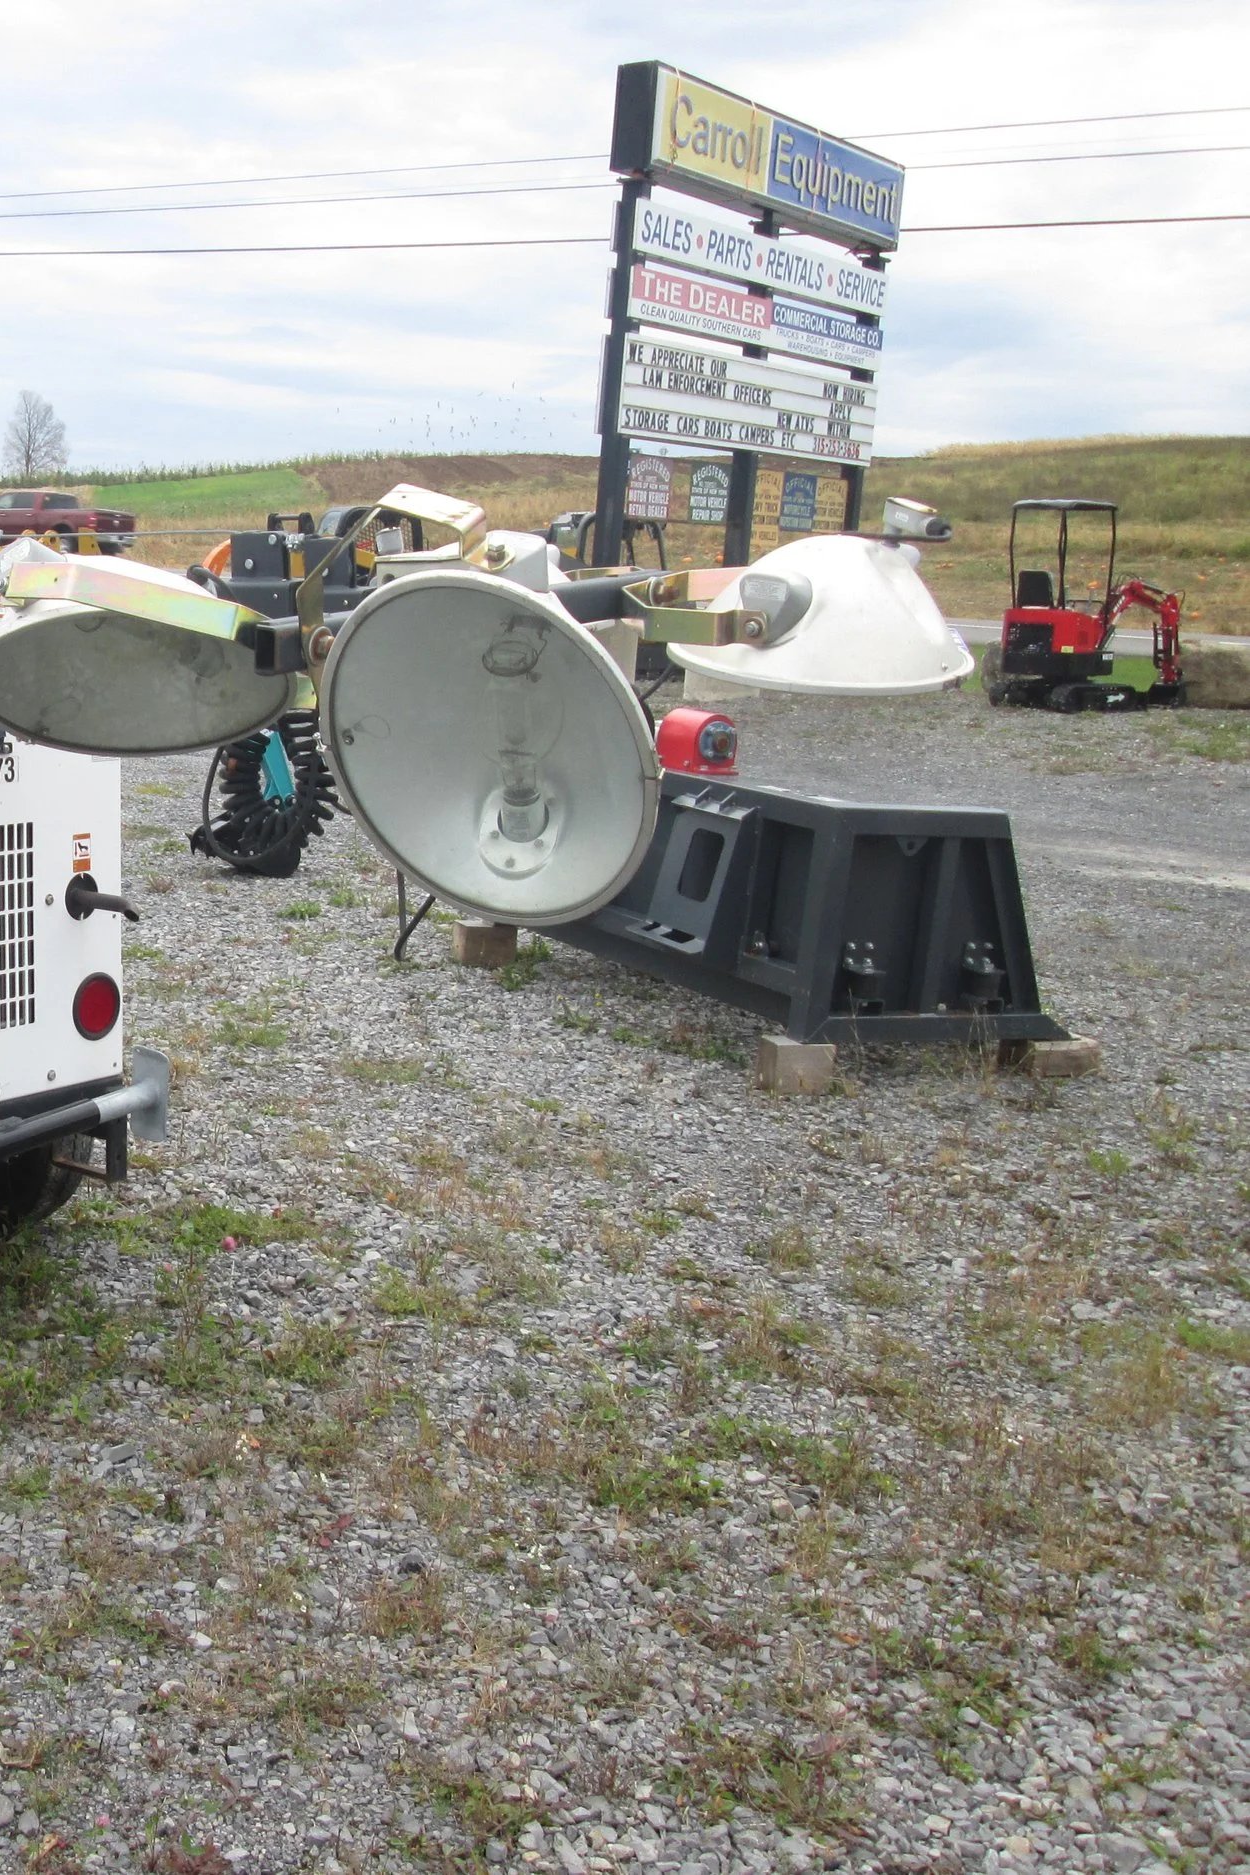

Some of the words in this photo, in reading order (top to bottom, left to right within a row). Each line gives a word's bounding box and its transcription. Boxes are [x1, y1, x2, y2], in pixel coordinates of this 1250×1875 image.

[670, 95, 764, 175] Carroll
[773, 132, 899, 224] Equipment
[641, 210, 693, 254] SALES
[706, 229, 753, 271] PARTS
[765, 248, 824, 291] RENTALS
[836, 269, 886, 308] SERVICE
[641, 271, 682, 305] THE
[689, 283, 766, 325] DEALER
[640, 303, 669, 319] CLEAN
[668, 311, 702, 326] QUALITY
[702, 318, 741, 336] SOUTHERN
[742, 327, 761, 340] CARS
[773, 305, 828, 334] COMMERCIAL
[830, 320, 867, 343] STORAGE
[867, 330, 880, 347] CO.
[775, 327, 799, 340] TRUCKS
[806, 334, 824, 346] BOATS
[830, 340, 846, 351] CARS
[851, 345, 876, 358] CAMPERS
[787, 341, 828, 357] WAREHOUSING
[834, 351, 865, 364] EQUIPMENT
[629, 343, 643, 362] WE
[651, 347, 704, 374] APPRECIATE
[711, 359, 727, 378] OUR
[642, 367, 663, 388] LAW
[668, 372, 727, 398] ENFORCEMENT
[734, 384, 772, 406] OFFICERS
[822, 382, 838, 399] NOW
[842, 386, 865, 405] HIRING
[776, 411, 792, 430] NEW
[829, 402, 852, 420] APPLY
[625, 408, 669, 431] STORAGE
[677, 416, 699, 435] CARS
[704, 419, 733, 440] BOATS
[739, 424, 775, 446] CAMPERS
[781, 431, 796, 449] ETC
[827, 420, 851, 439] WITHIN
[631, 459, 670, 482] REGISTERED
[692, 464, 729, 488] REGISTERED
[629, 489, 647, 502] MOTOR
[648, 491, 670, 505] VEHICLE
[690, 495, 707, 507] MOTOR
[708, 497, 727, 509] VEHICLE
[628, 503, 646, 516] RETAIL
[648, 505, 667, 519] DEALER
[692, 509, 710, 521] REPAIR
[711, 510, 724, 521] SHOP
